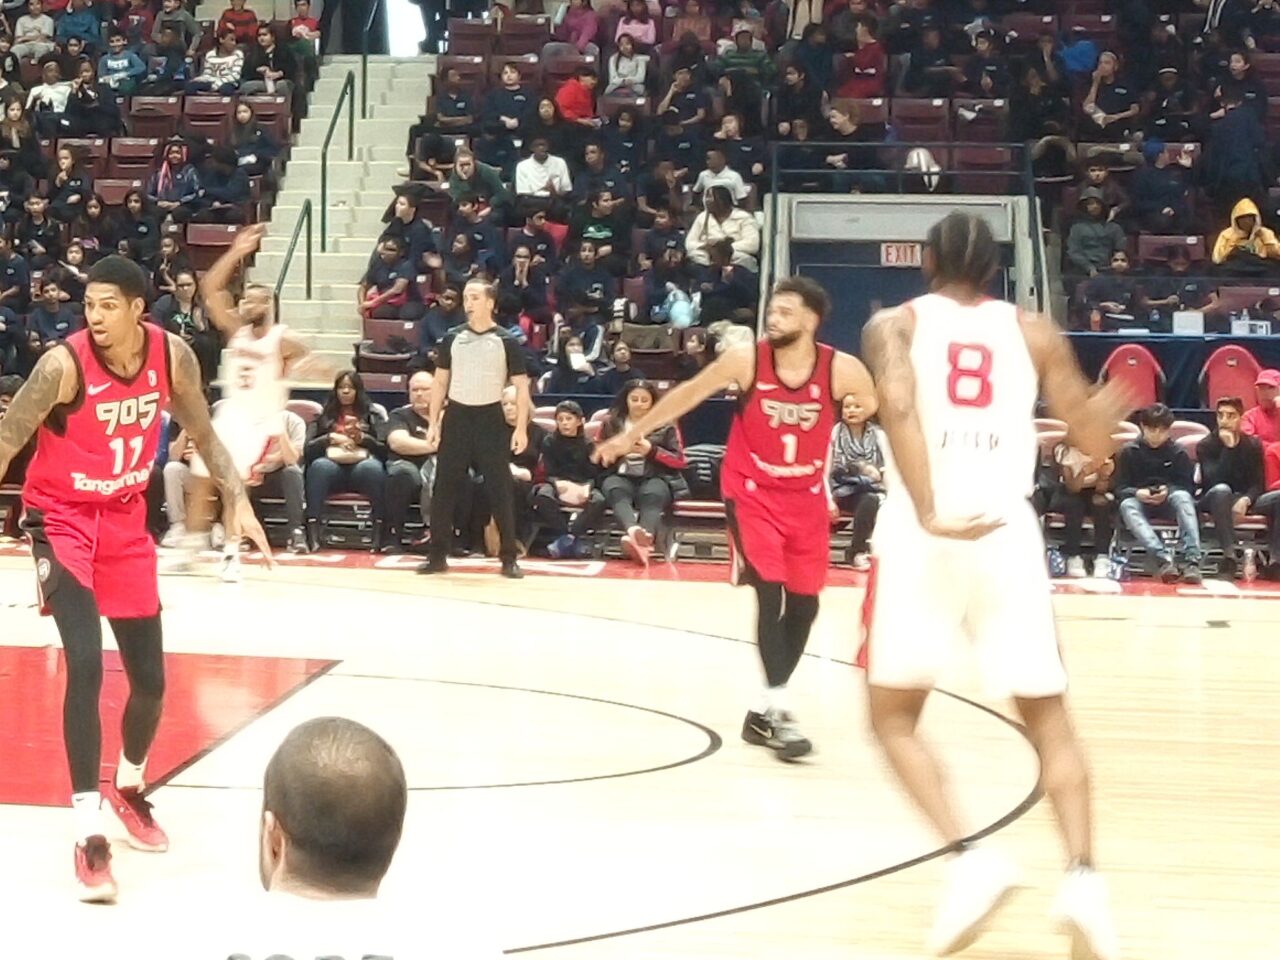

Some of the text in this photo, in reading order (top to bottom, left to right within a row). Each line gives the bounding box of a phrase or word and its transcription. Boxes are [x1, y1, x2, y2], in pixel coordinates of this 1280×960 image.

[885, 244, 917, 264] EXIT
[947, 341, 994, 408] 8
[95, 391, 161, 436] 905
[759, 398, 823, 432] 905
[107, 435, 145, 476] 11
[780, 433, 799, 464] 1
